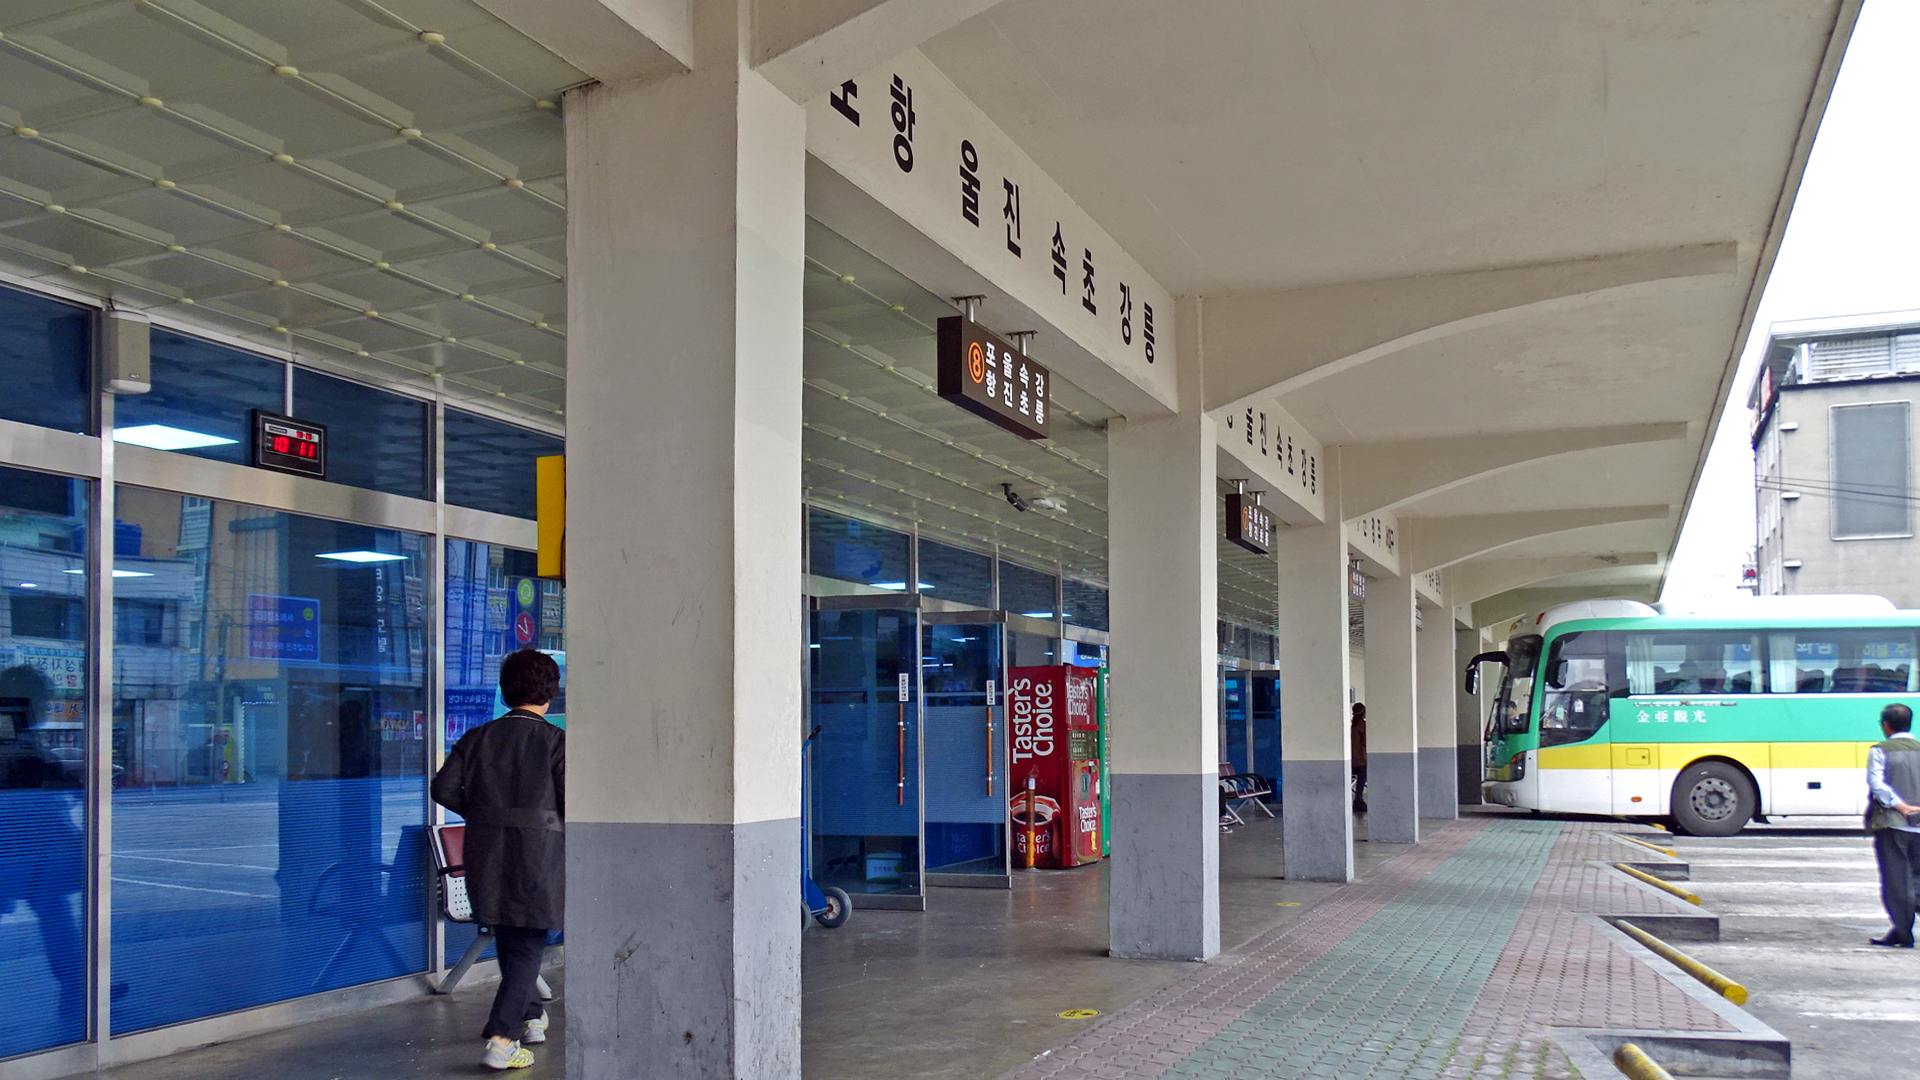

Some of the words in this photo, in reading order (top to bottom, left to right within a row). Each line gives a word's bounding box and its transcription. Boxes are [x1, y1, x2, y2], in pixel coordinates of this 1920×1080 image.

[959, 139, 1021, 259] 울진
[1051, 220, 1097, 316] 속초
[1119, 281, 1155, 364] 강릉
[985, 341, 996, 398] 포항
[1002, 352, 1013, 408] 울진
[1019, 363, 1030, 416] 속초
[1034, 372, 1045, 425] 강릉
[273, 436, 290, 453] 10
[300, 441, 315, 458] 11
[1277, 425, 1294, 476] 속초
[1301, 448, 1316, 495] 강릉
[1008, 678, 1033, 764] Taster's
[1016, 829, 1051, 843] Taer's
